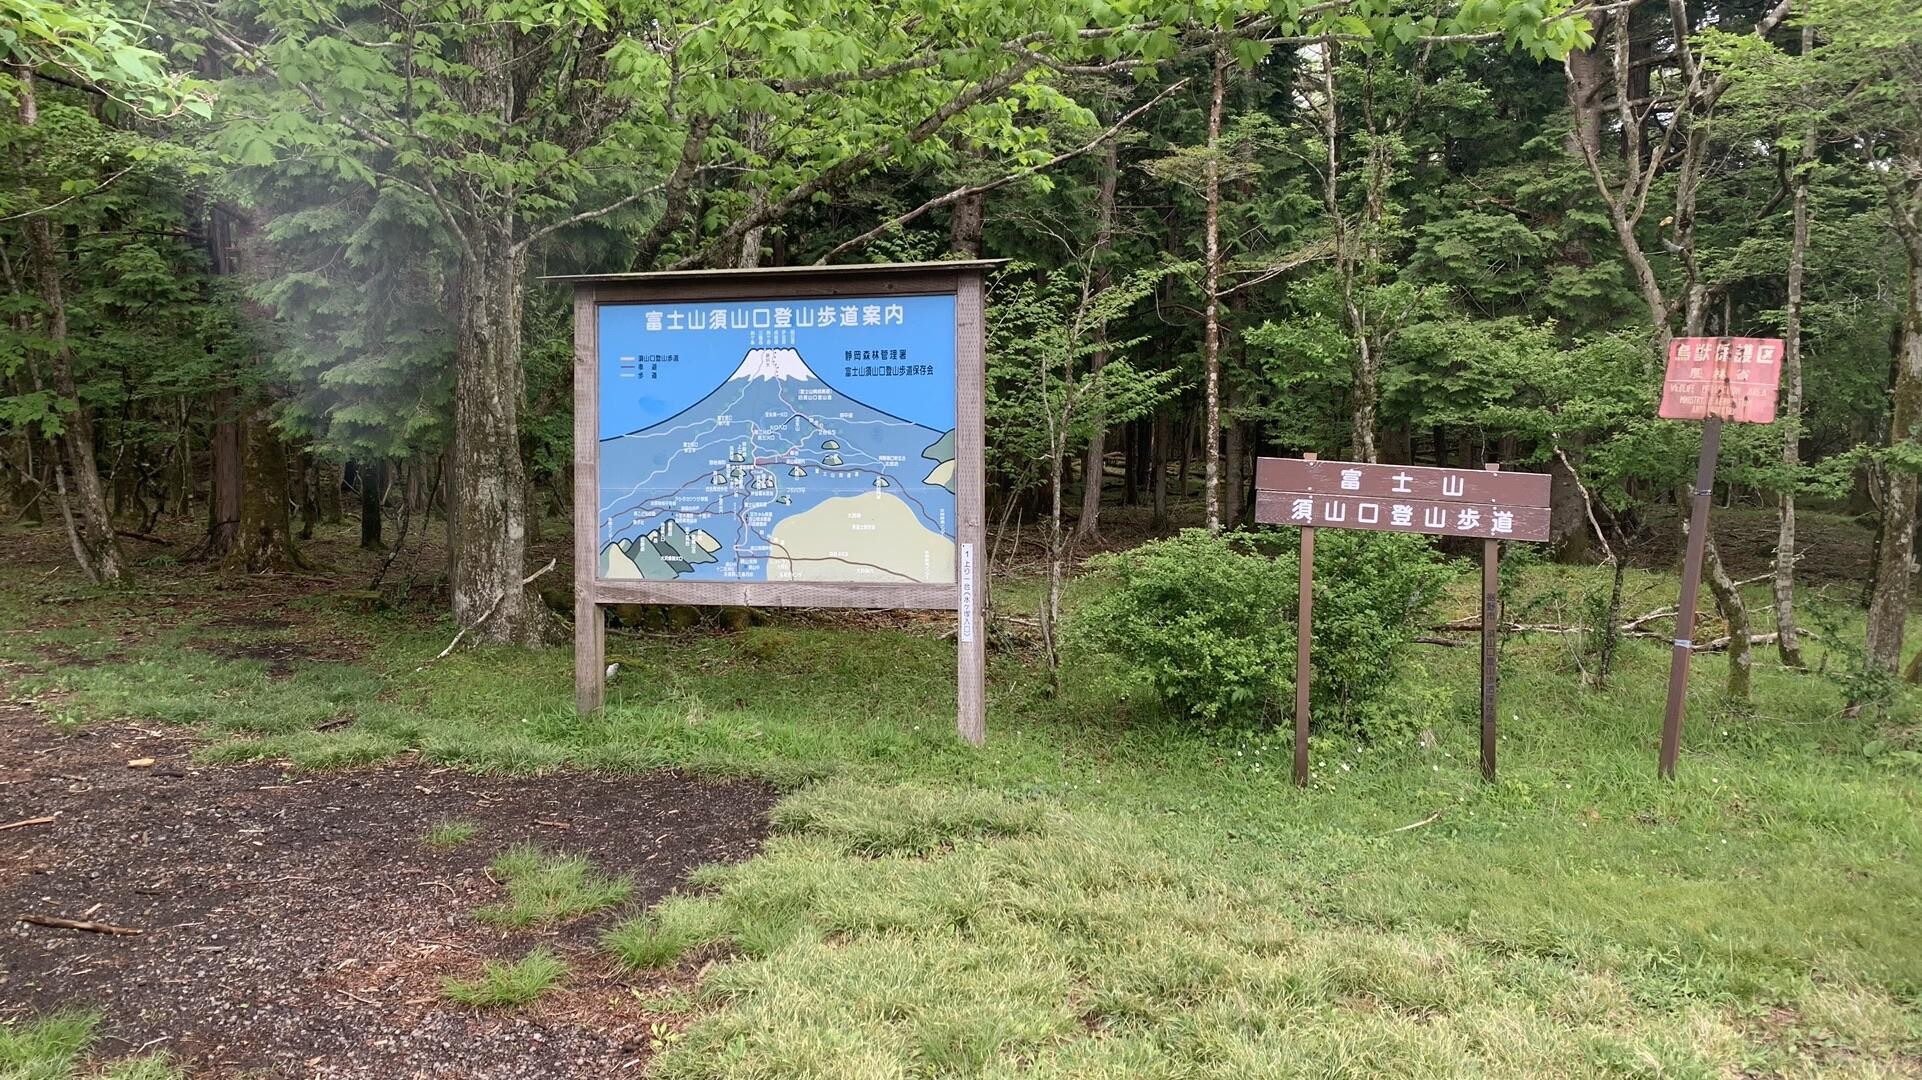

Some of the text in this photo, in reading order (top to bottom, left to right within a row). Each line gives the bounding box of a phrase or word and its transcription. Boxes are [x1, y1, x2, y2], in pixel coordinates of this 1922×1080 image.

[645, 304, 904, 331] 富士山須山口登山歩道案内
[845, 349, 907, 361] 静岡森林管理署
[844, 364, 934, 377] 富士山須山口登山歩道保存会
[1341, 469, 1464, 497] 富士山
[1291, 498, 1513, 534] 須山口登山歩道
